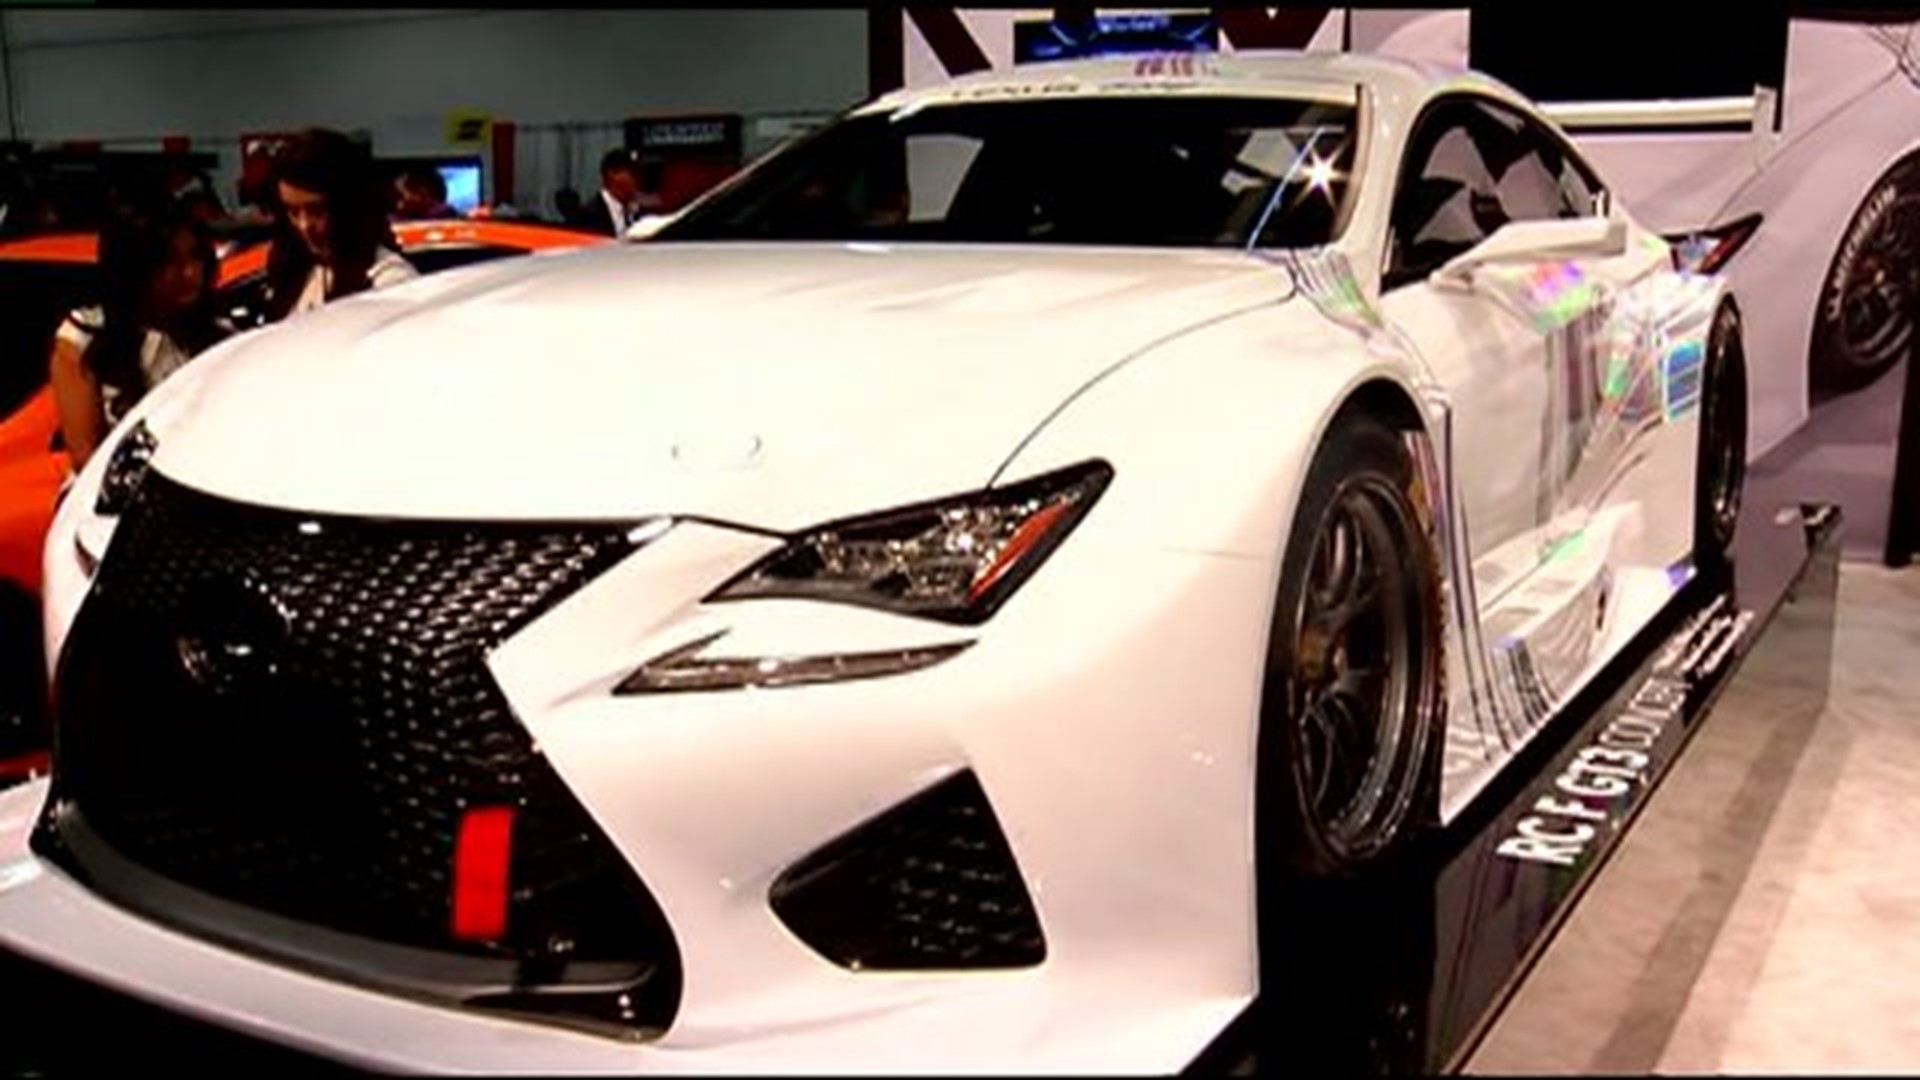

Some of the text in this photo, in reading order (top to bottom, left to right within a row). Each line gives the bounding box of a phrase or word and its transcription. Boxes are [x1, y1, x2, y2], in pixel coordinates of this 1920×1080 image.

[1556, 745, 1649, 798] GT3
[1535, 795, 1607, 820] F
[1496, 816, 1595, 866] RC
